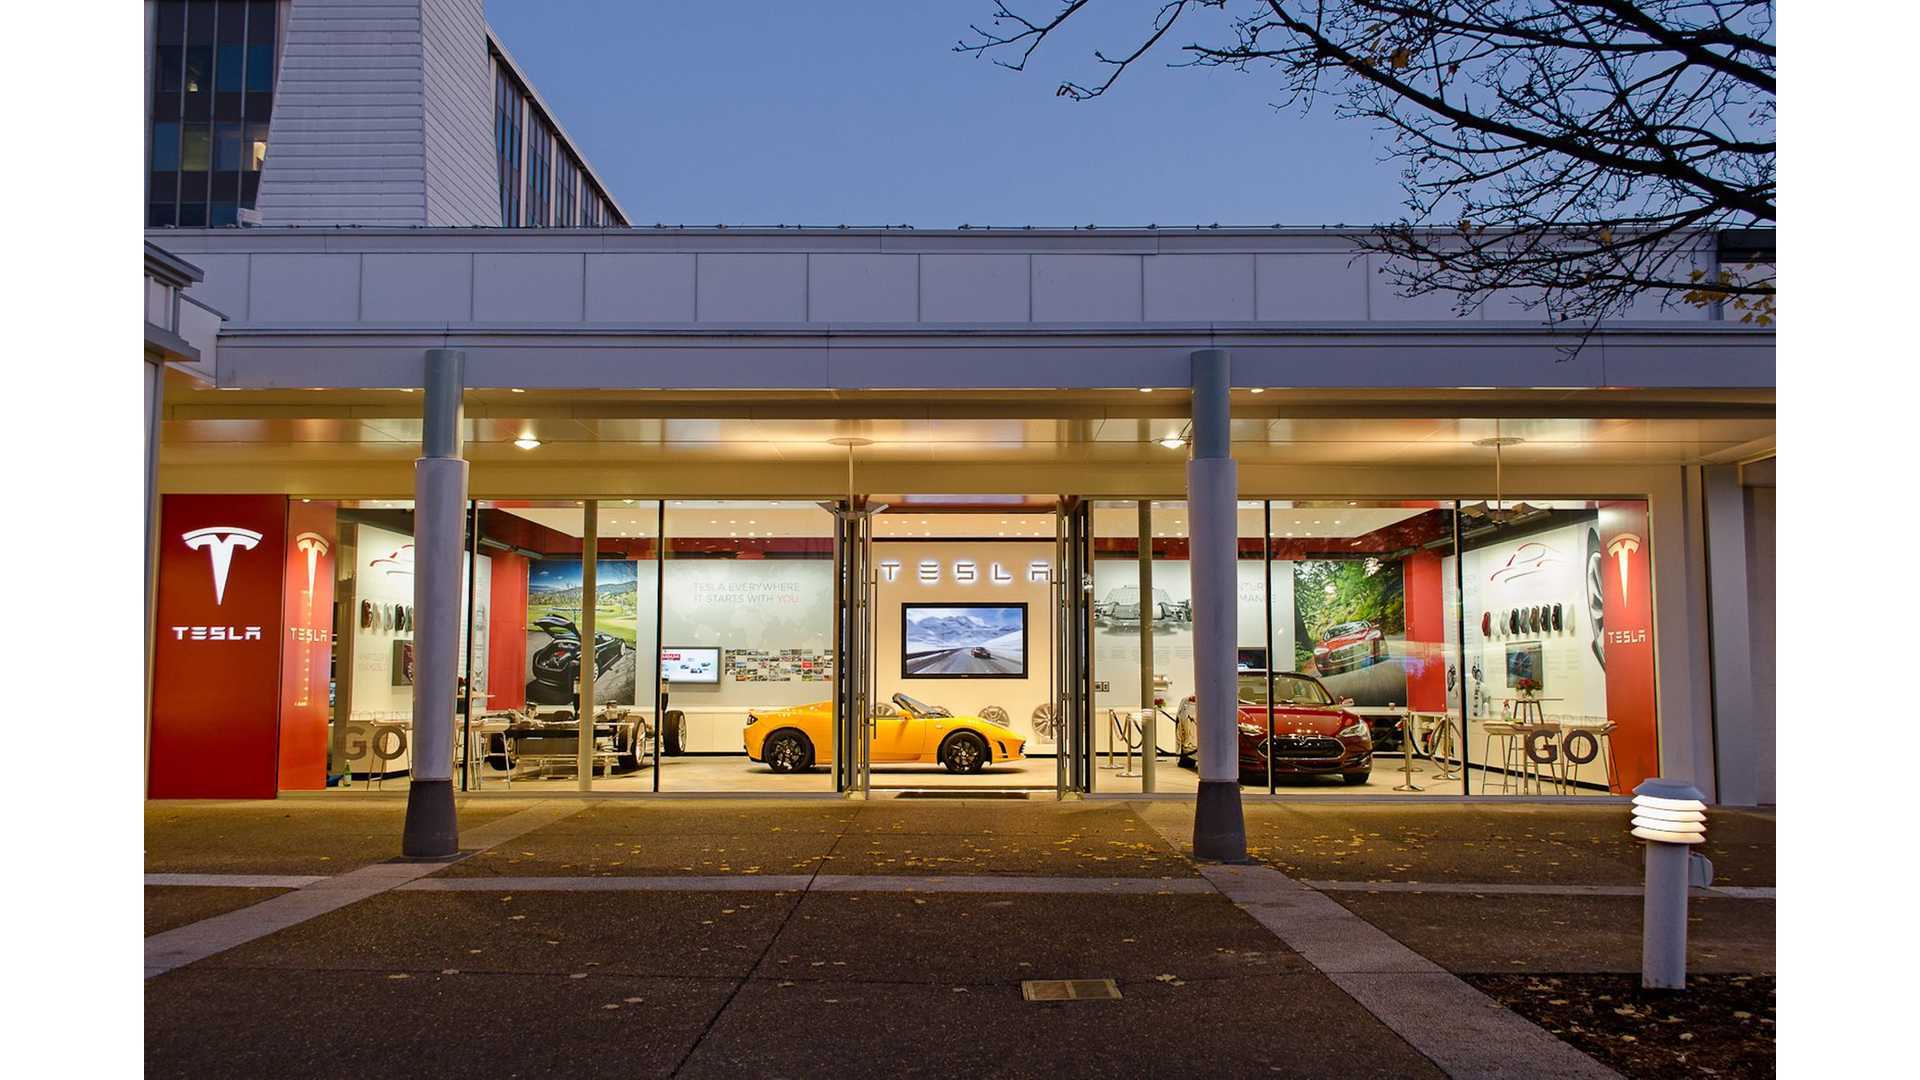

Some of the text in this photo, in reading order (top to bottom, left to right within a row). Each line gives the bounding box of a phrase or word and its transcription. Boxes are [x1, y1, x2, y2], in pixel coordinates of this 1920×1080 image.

[881, 563, 1049, 581] TESLA
[728, 583, 800, 592] EVERYWHERE
[704, 594, 744, 603] STARTS
[747, 594, 774, 603] WITH
[173, 626, 261, 641] TESLA
[289, 628, 328, 642] TESLA
[1608, 629, 1646, 644] TESLA
[336, 726, 407, 760] GO
[1527, 730, 1598, 764] GO
